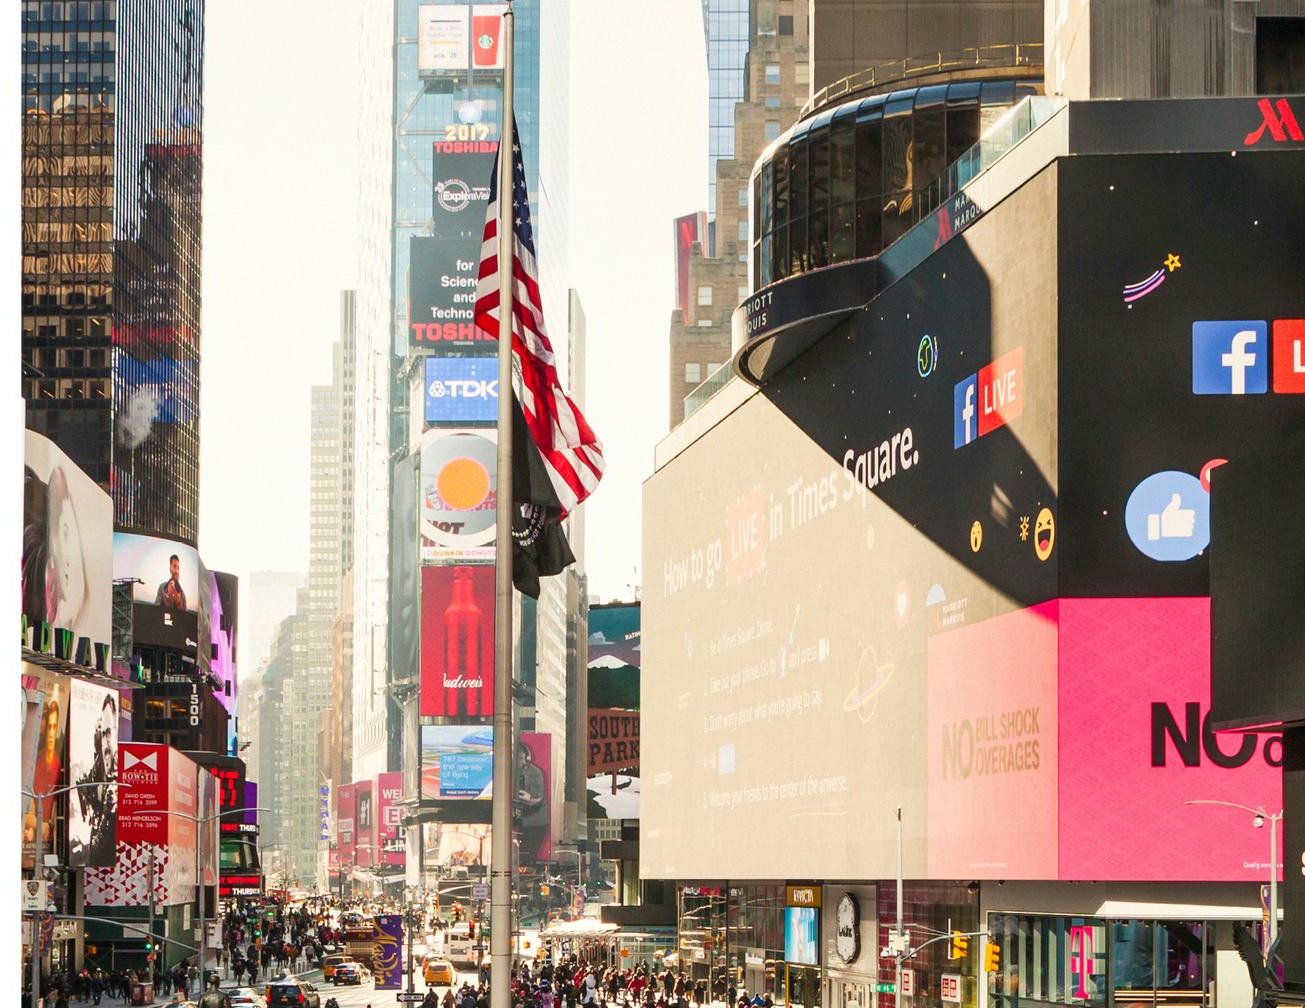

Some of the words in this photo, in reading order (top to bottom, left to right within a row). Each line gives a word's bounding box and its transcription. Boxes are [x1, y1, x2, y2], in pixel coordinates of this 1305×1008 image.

[445, 124, 490, 141] 2017
[433, 142, 500, 153] TOSHIBA
[456, 259, 475, 271] for
[453, 291, 476, 303] and
[445, 380, 498, 398] TDK
[984, 368, 1017, 416] LIVE
[663, 558, 689, 598] How
[690, 546, 705, 584] to
[706, 539, 723, 590] go
[730, 511, 758, 561] LIVE
[769, 492, 785, 541] in
[786, 471, 838, 531] Times
[843, 427, 919, 509] Square.
[189, 683, 200, 727] 1500
[589, 738, 640, 766] PARK
[942, 717, 975, 780] NO
[976, 714, 998, 744] BILL
[999, 706, 1041, 739] SHOCK
[976, 739, 1041, 778] OVERAGES
